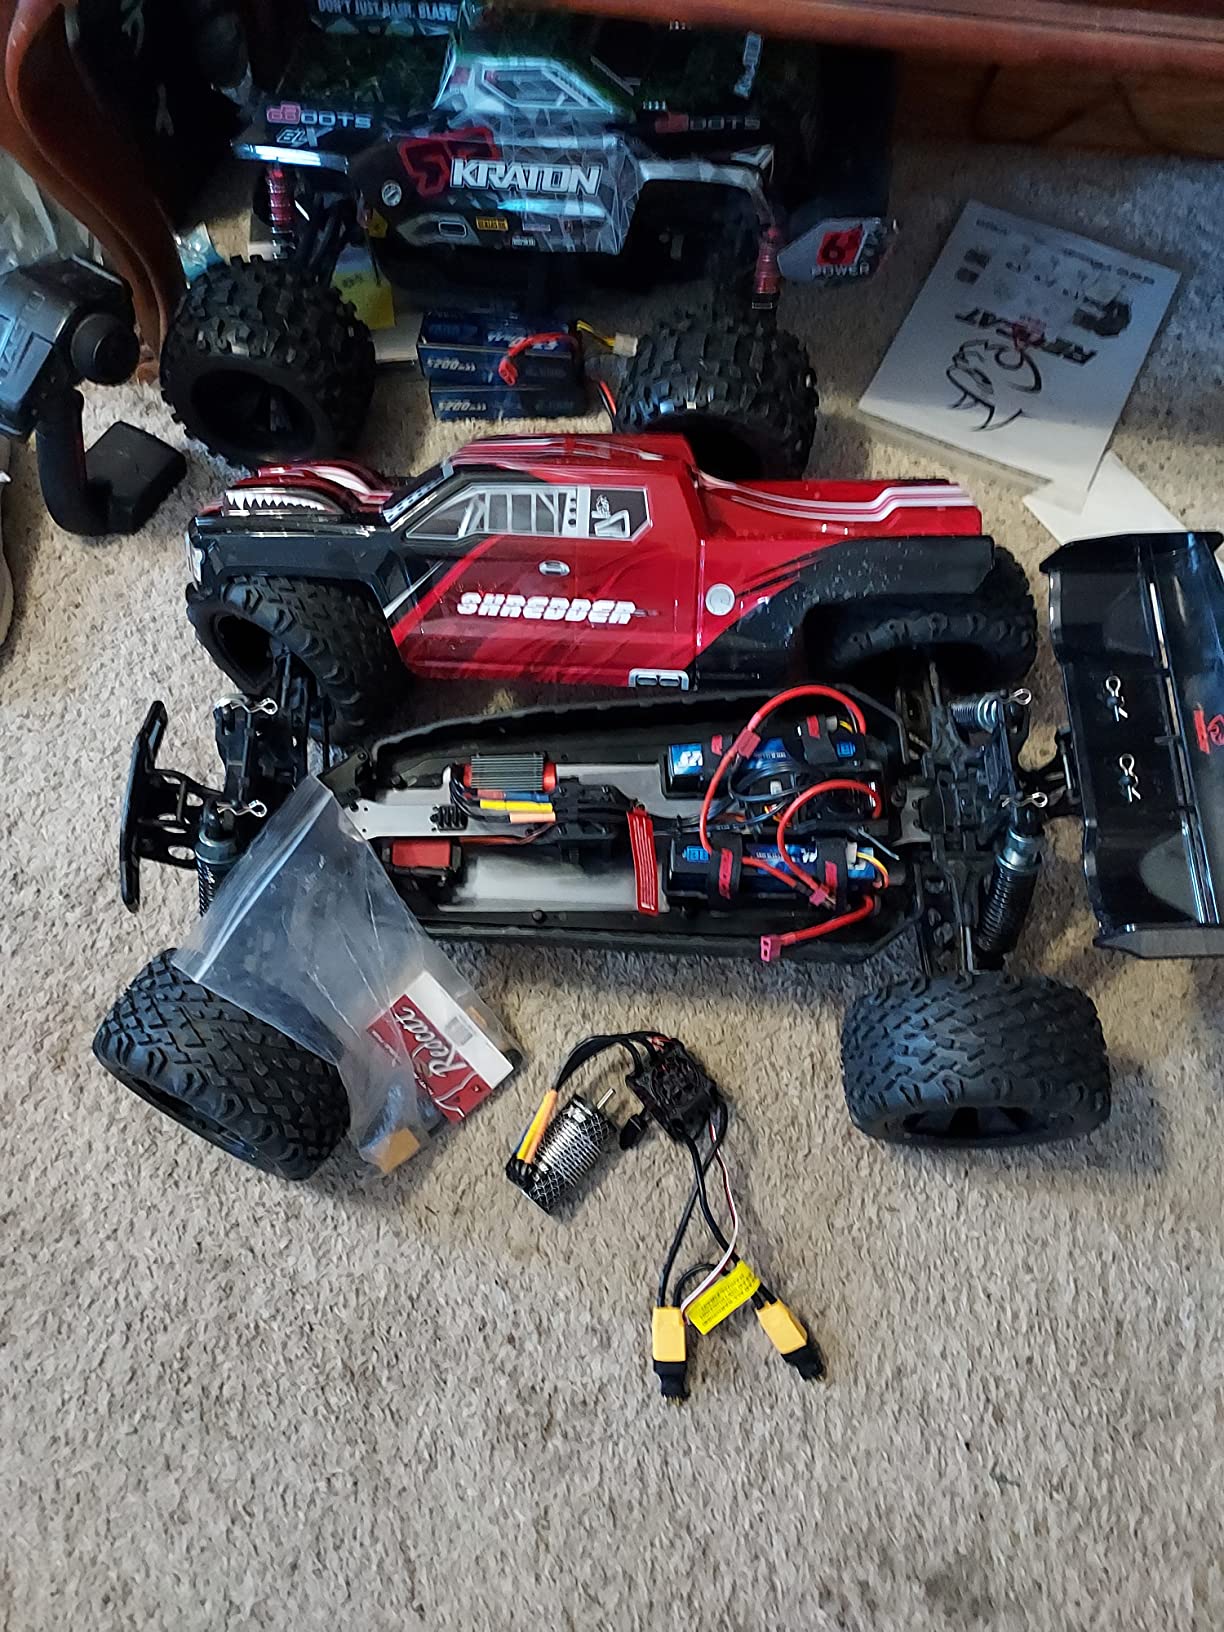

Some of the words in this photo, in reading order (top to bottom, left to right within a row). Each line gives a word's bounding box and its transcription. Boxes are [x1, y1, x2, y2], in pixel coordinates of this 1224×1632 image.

[451, 157, 601, 196] KRATON
[811, 262, 870, 279] POWER
[457, 591, 637, 625] SHREDDER
[392, 1006, 468, 1079] Redcat
